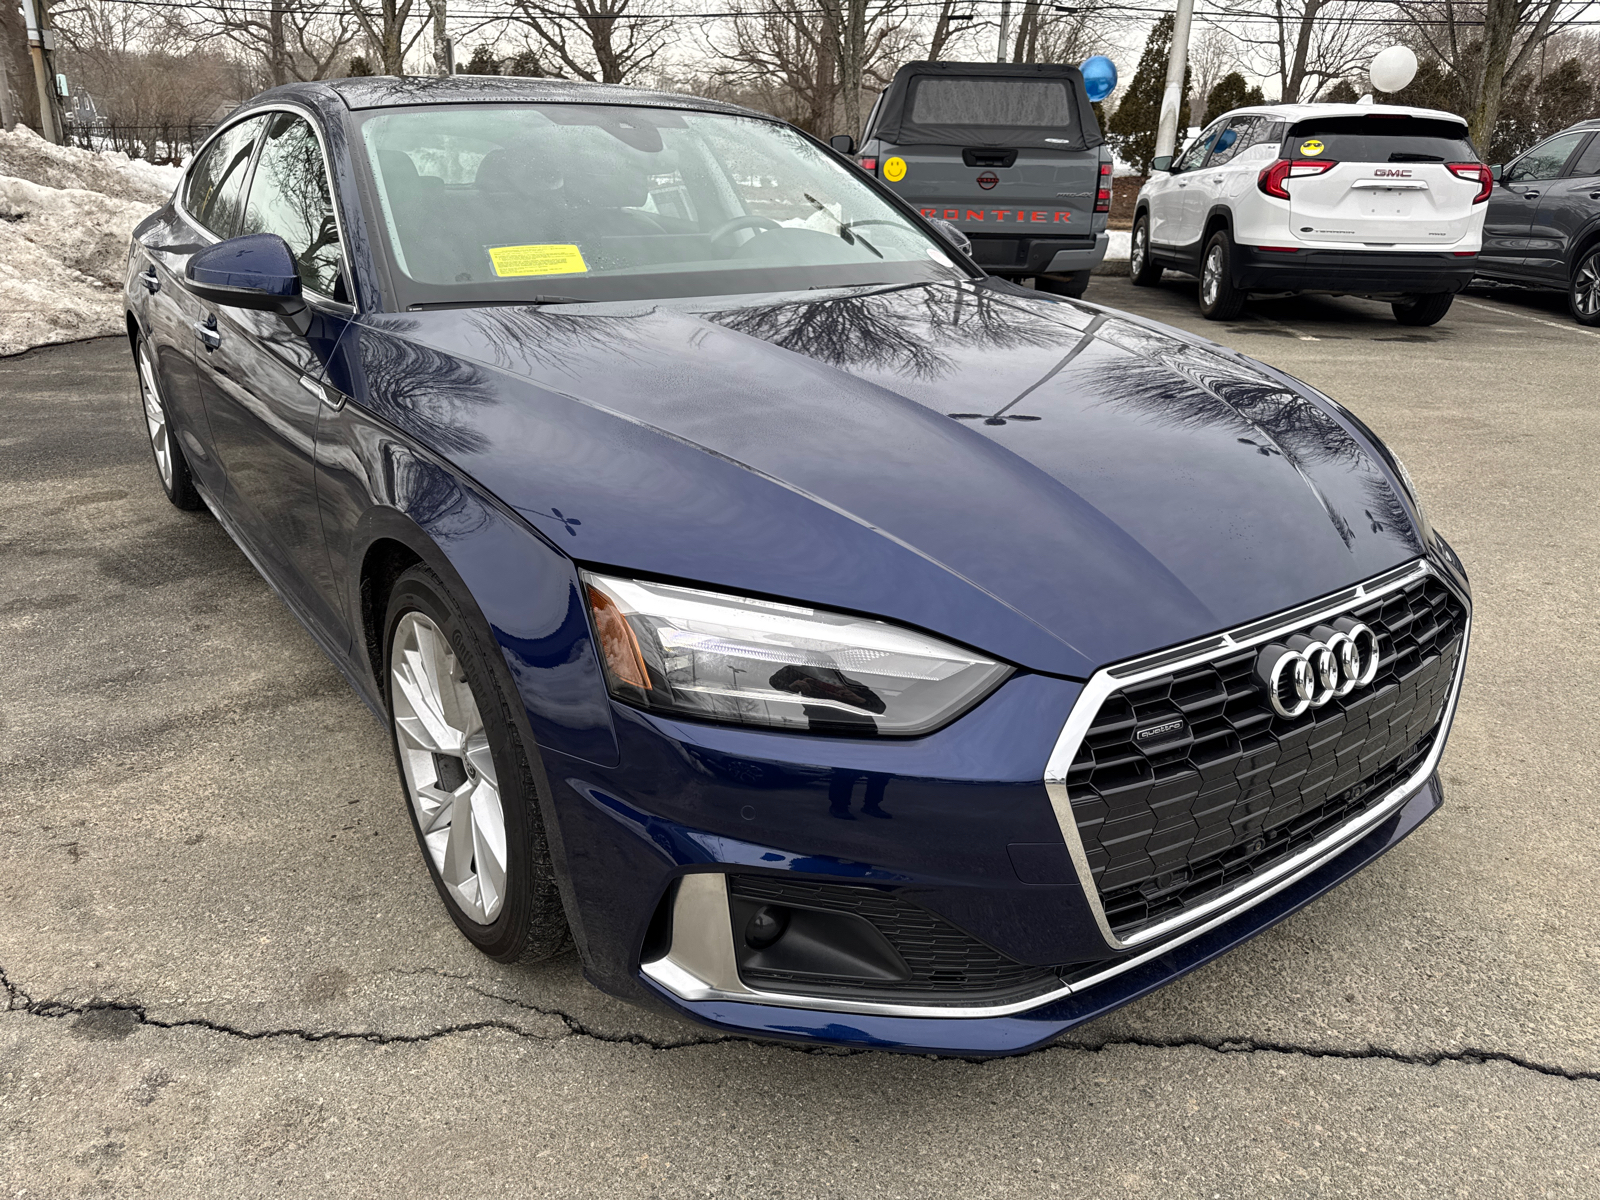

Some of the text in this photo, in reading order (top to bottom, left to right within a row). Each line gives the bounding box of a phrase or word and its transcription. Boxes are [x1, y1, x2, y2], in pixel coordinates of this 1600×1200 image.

[1374, 169, 1412, 177] GMC
[920, 208, 1072, 223] RONTIER
[1141, 722, 1181, 738] quattro
